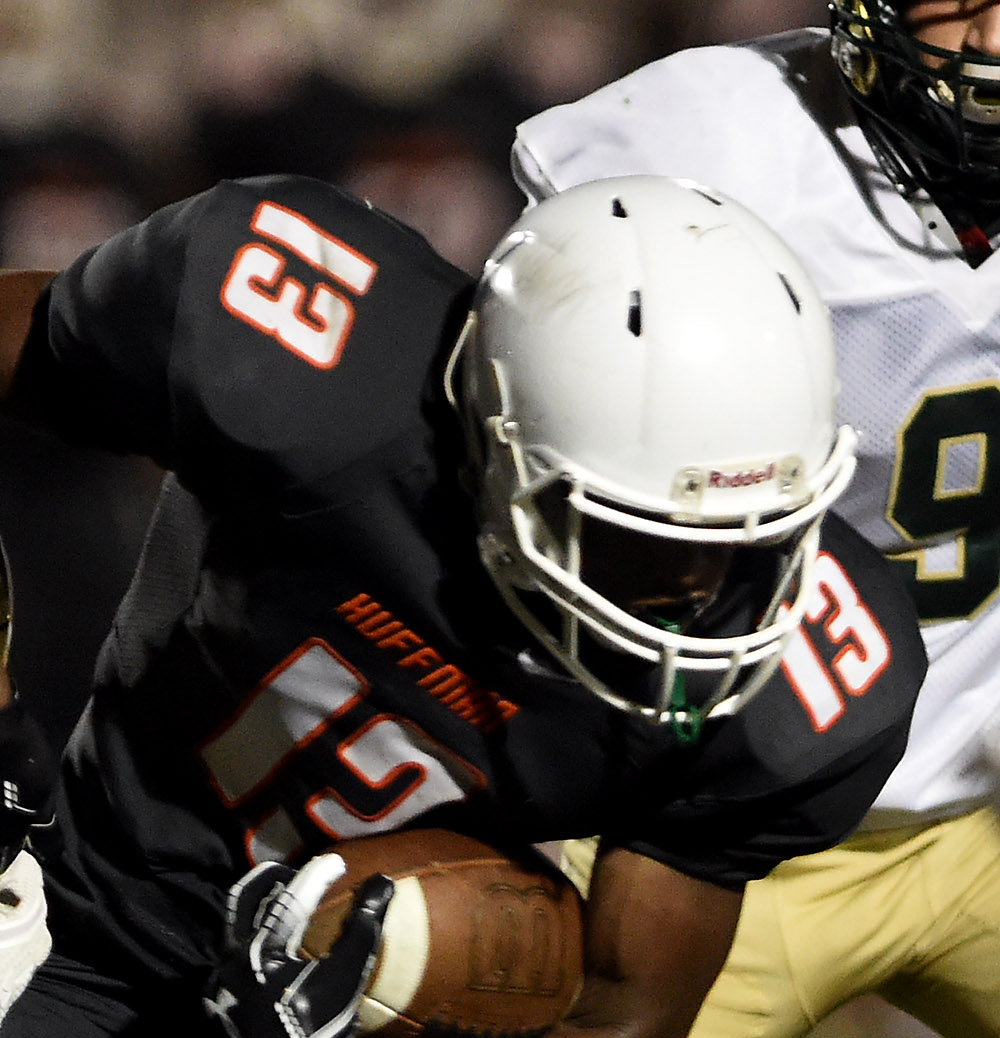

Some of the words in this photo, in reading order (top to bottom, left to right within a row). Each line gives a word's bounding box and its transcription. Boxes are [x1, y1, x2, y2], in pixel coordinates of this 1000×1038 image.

[219, 200, 379, 371] 13
[708, 461, 776, 488] Riddell
[884, 378, 1000, 632] 9
[759, 550, 892, 734] 13
